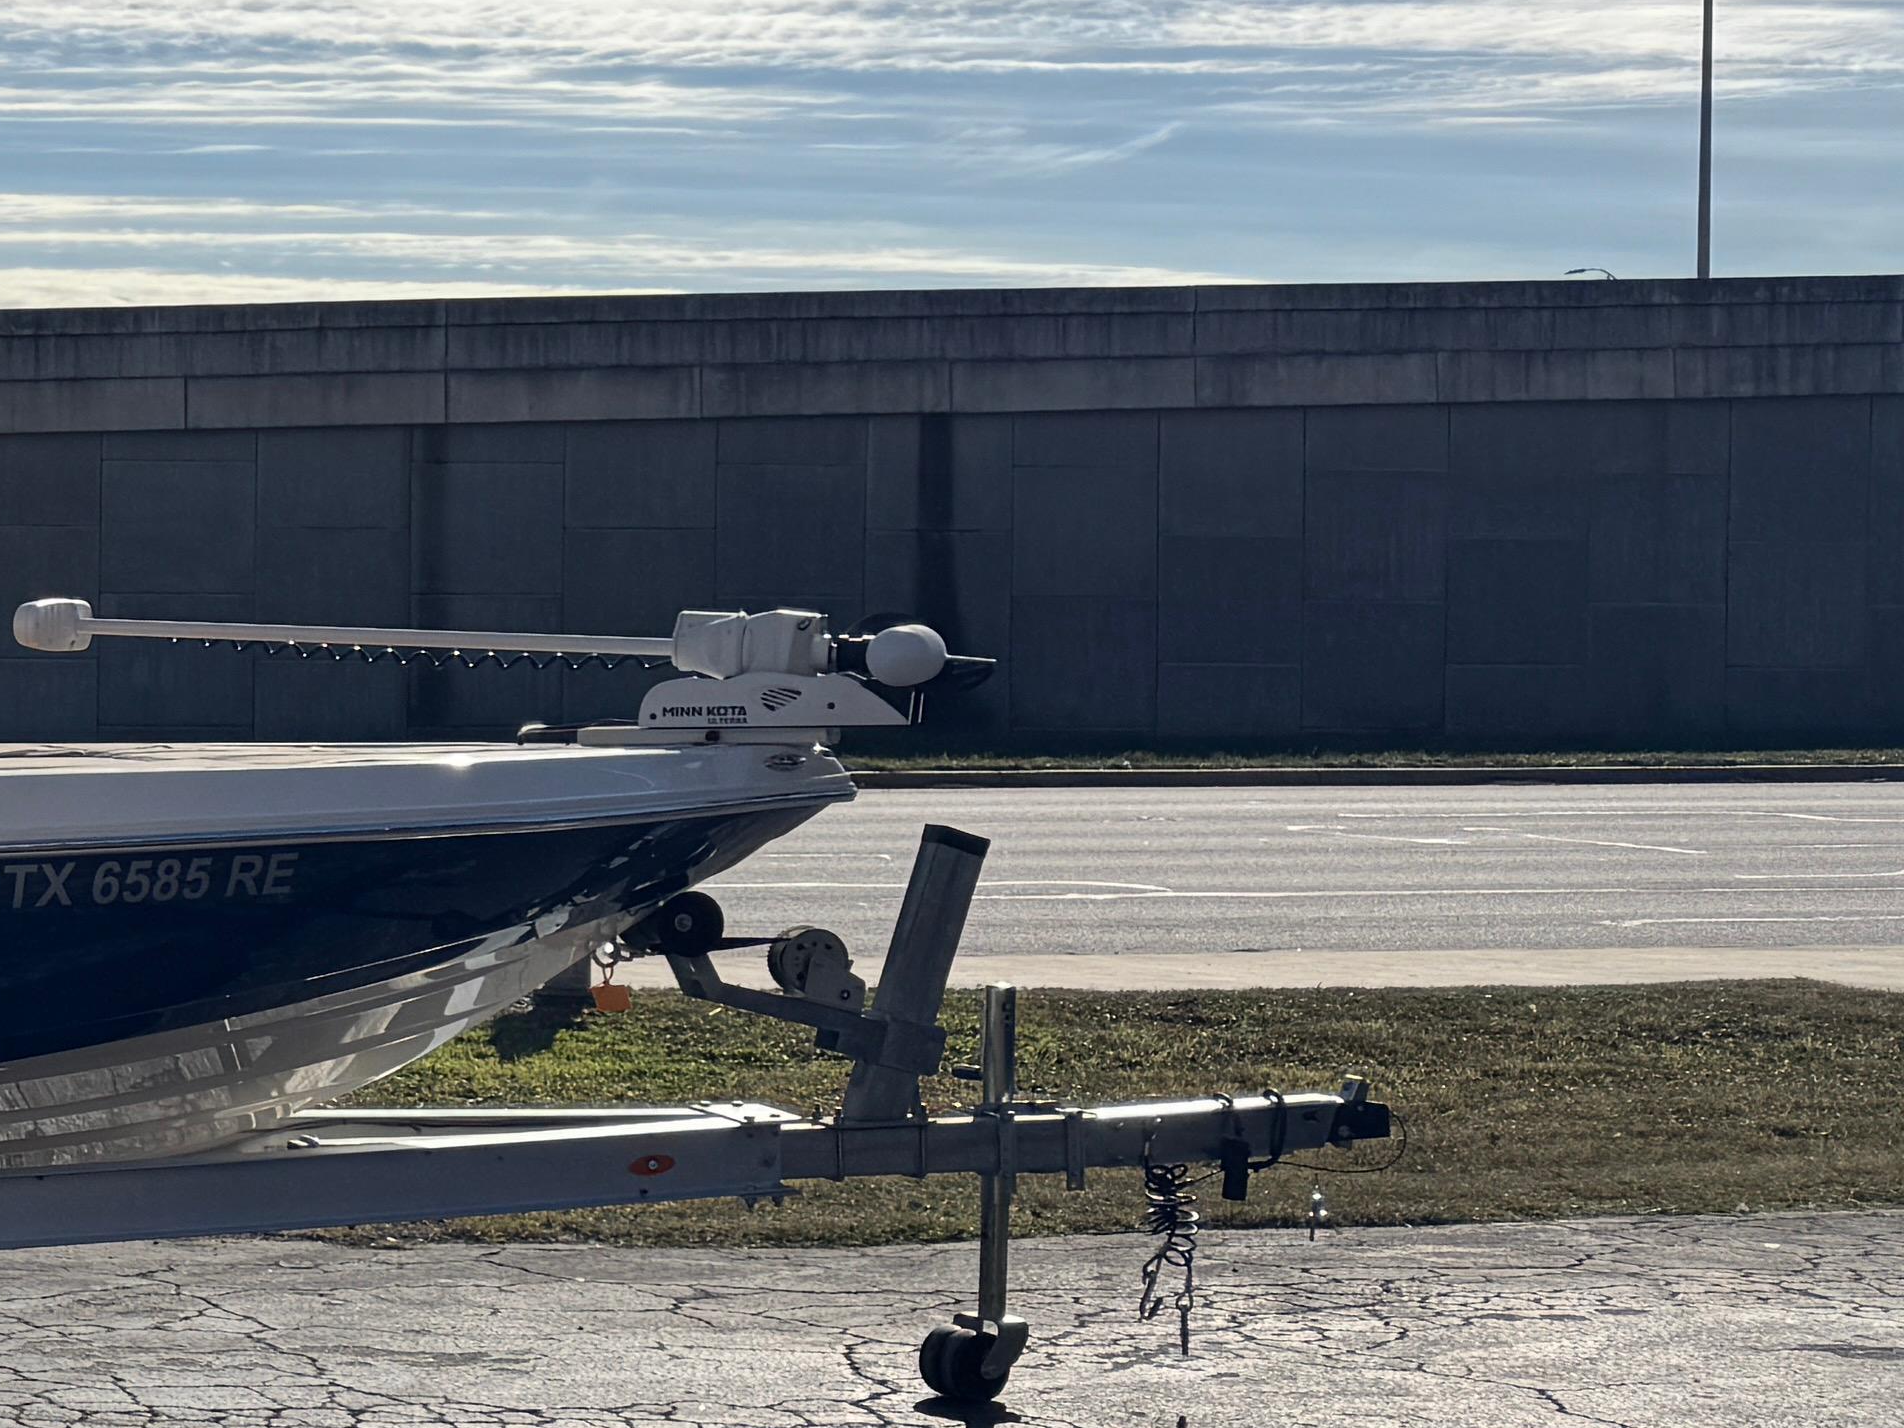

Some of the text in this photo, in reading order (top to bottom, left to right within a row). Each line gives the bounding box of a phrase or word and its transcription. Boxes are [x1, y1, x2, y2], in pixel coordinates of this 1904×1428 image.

[662, 705, 748, 717] MINN KOTA
[4, 861, 76, 909] TX
[92, 857, 213, 906] 6585
[225, 852, 300, 898] RE
